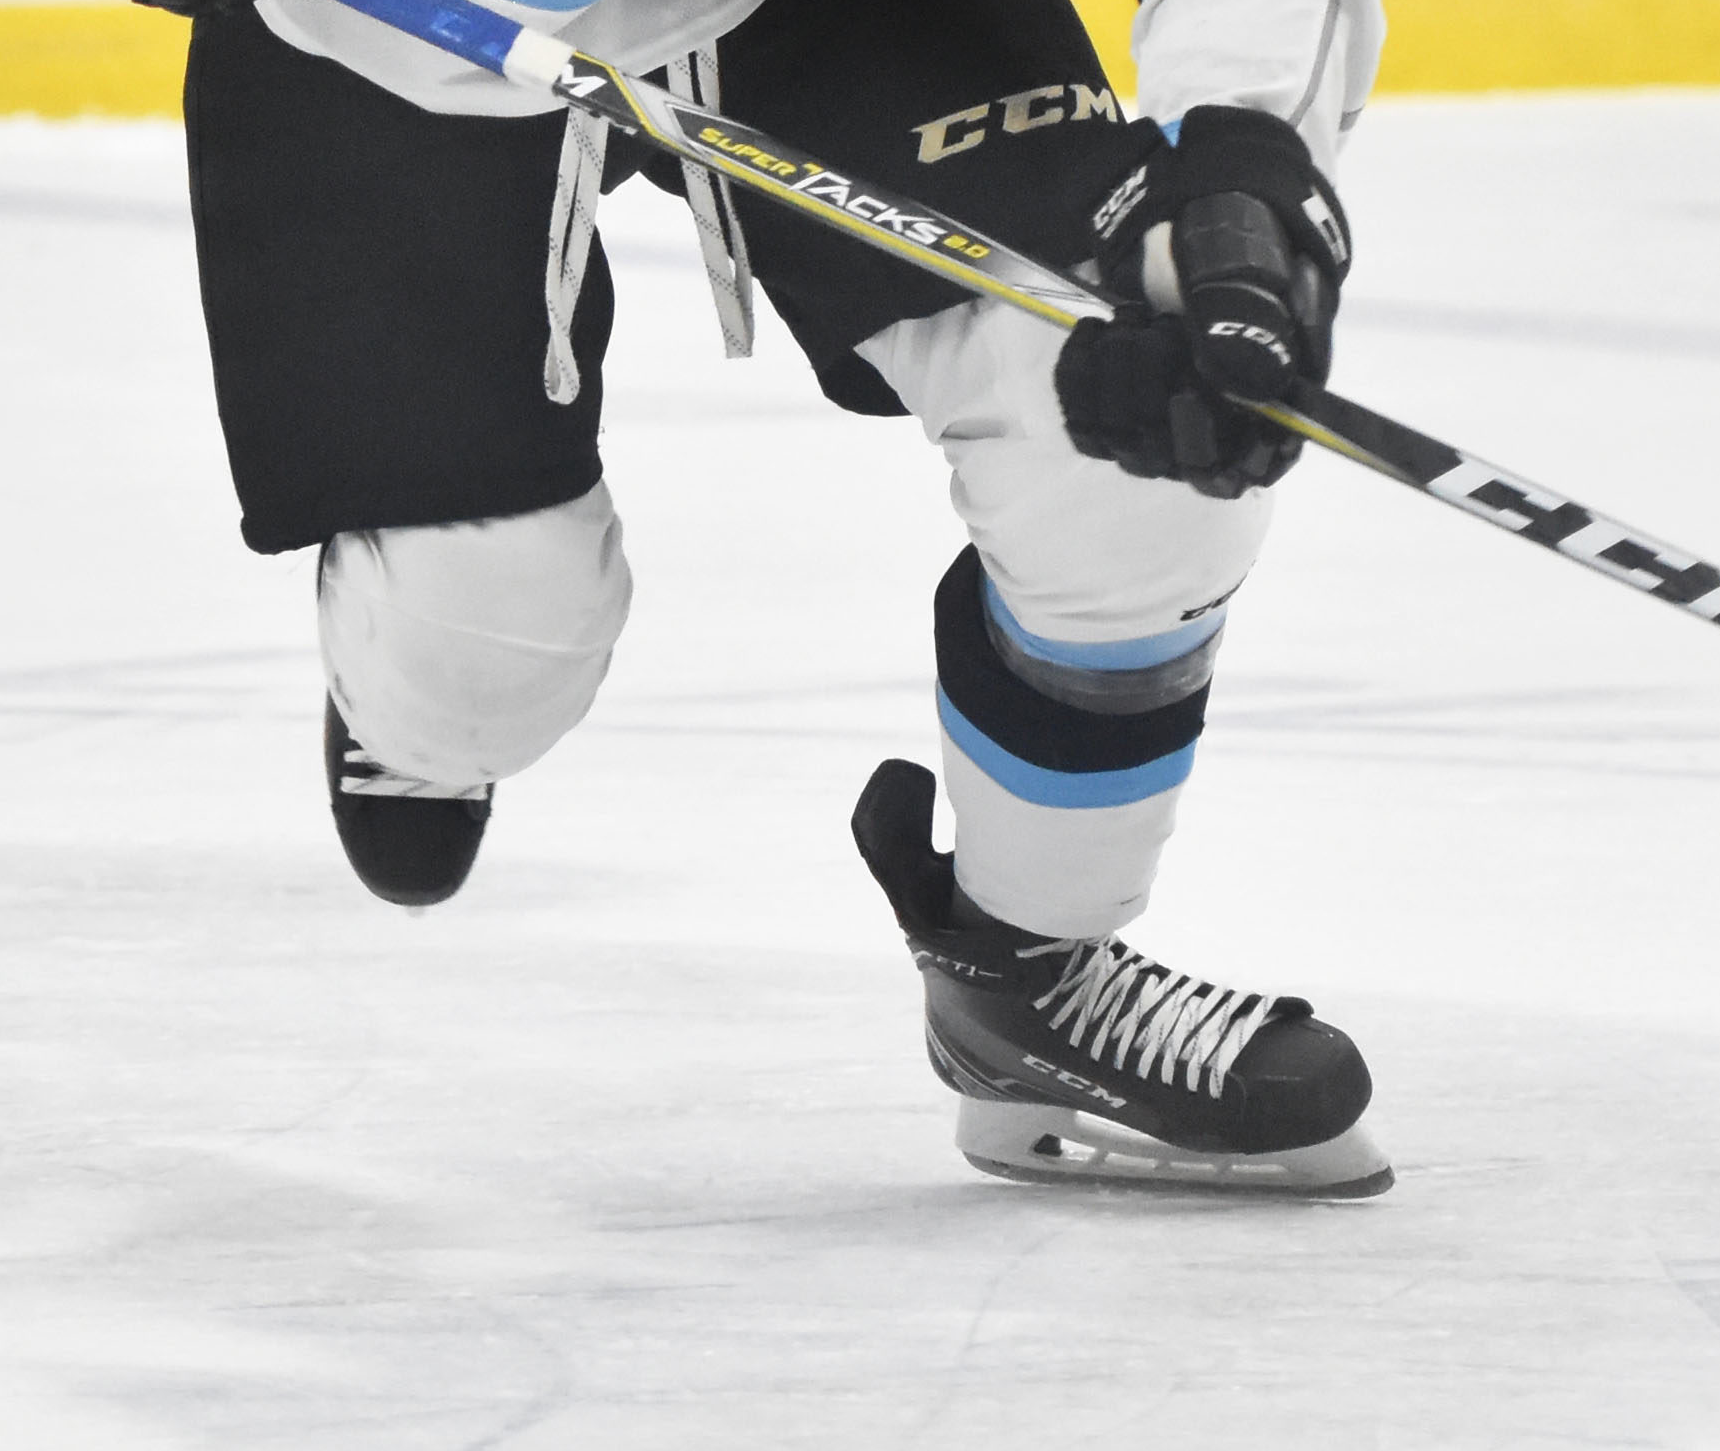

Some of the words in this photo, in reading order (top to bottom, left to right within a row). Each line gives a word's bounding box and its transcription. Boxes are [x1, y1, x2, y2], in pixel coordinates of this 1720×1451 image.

[697, 126, 798, 177] SUPER
[910, 83, 1119, 165] CCM
[1021, 1053, 1128, 1109] CCM
